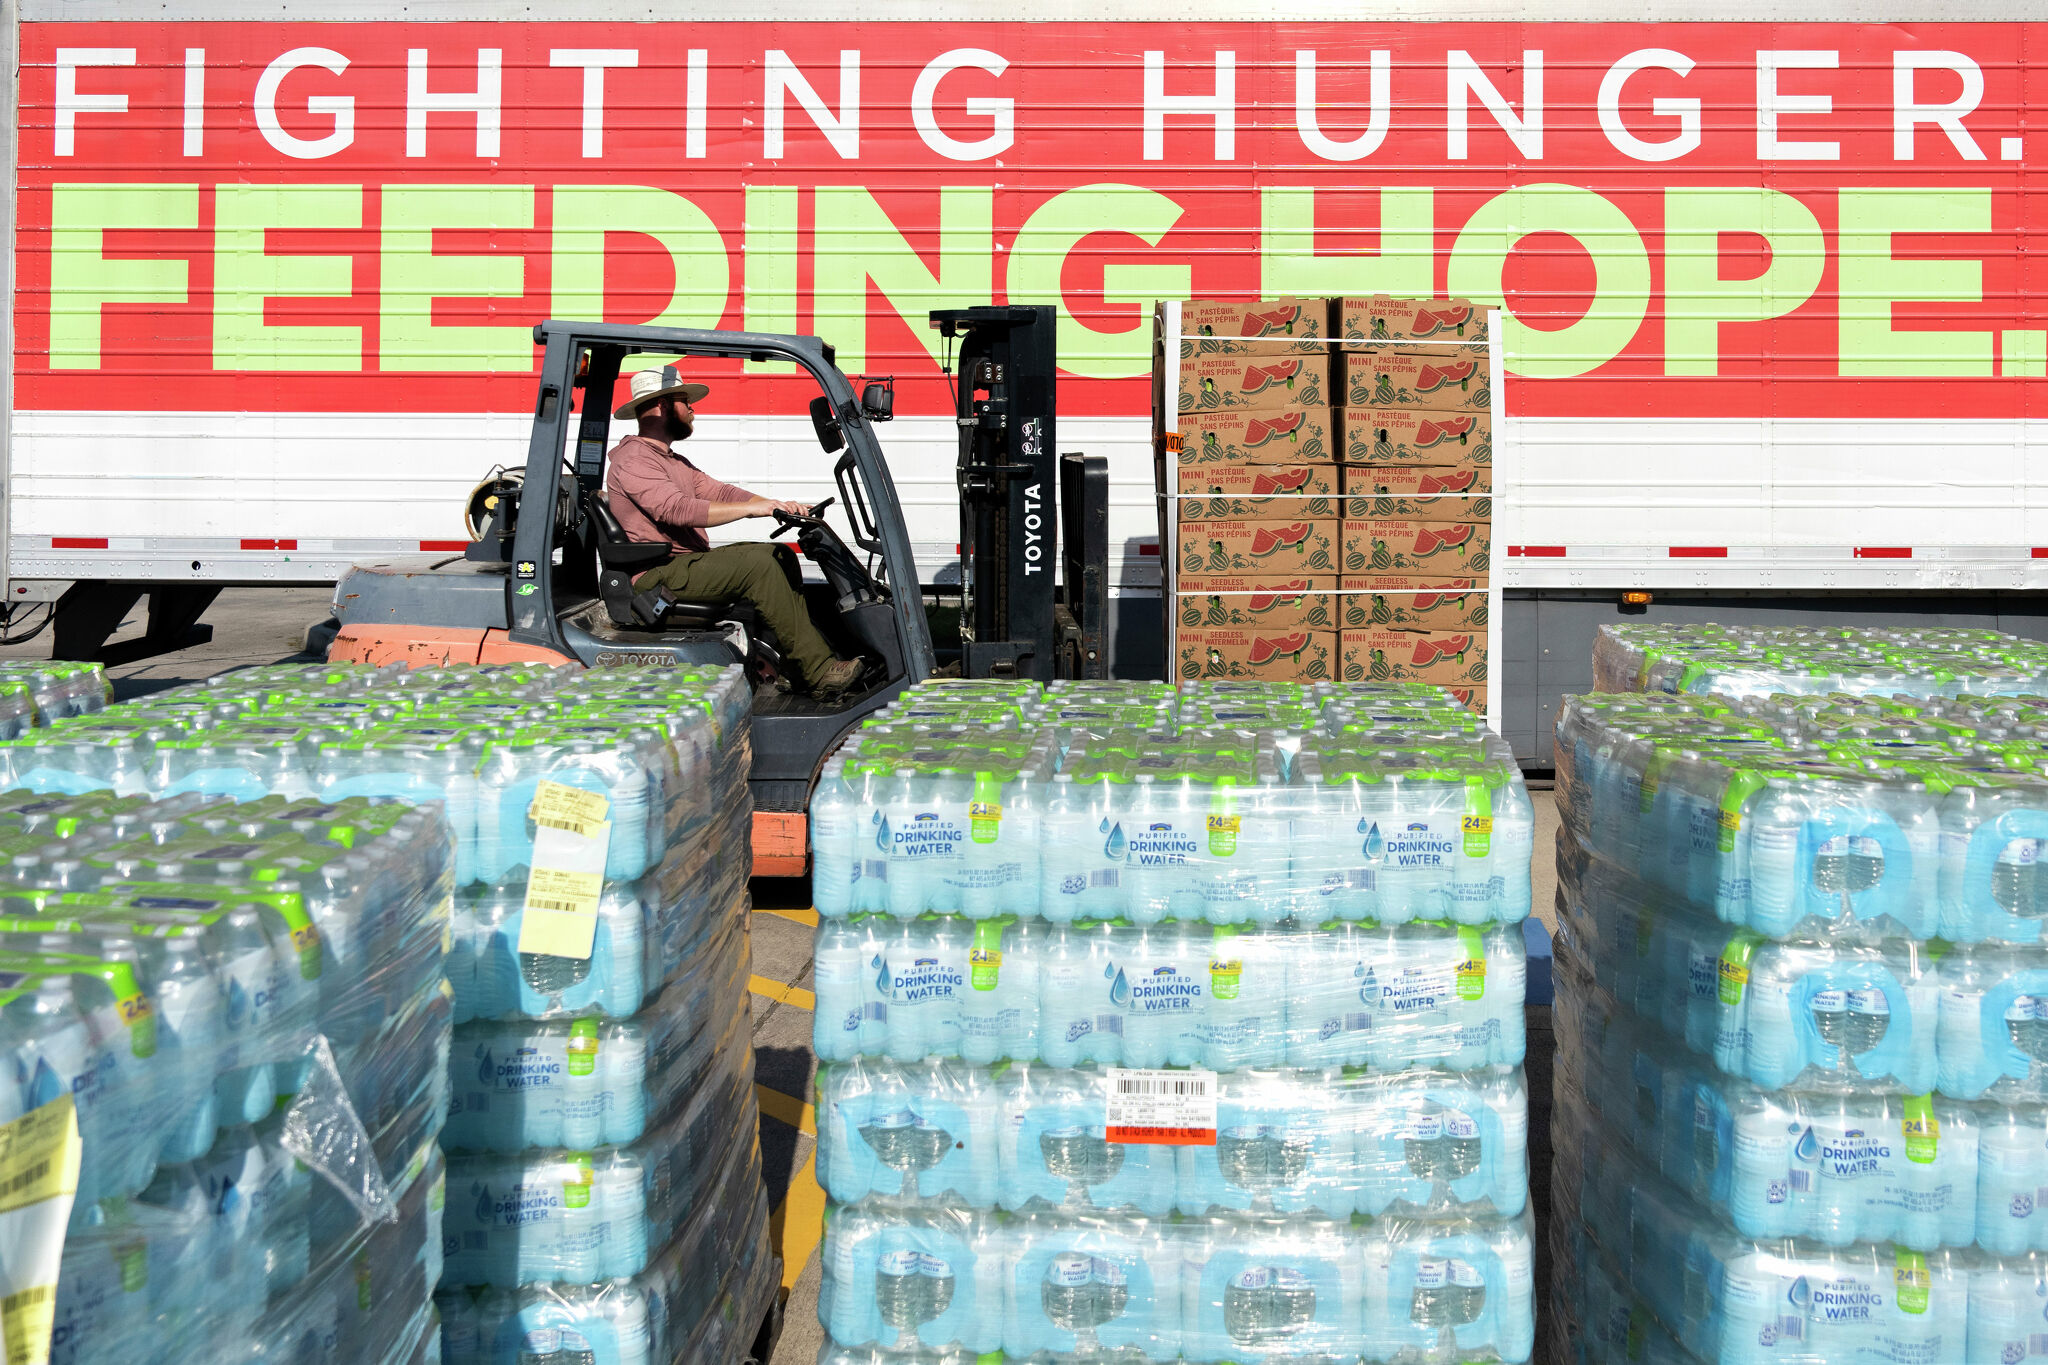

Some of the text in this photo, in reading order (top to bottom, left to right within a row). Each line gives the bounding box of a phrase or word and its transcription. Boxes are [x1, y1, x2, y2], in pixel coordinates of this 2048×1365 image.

[53, 46, 2023, 162] FIGHTING HUNGER.
[49, 182, 2048, 380] FEEDING HOPE.
[1345, 300, 1368, 309] MINI
[1374, 300, 1408, 309] PASTÈQUE
[1181, 311, 1194, 320] INI
[1200, 307, 1235, 316] PASTÈQUE
[1369, 308, 1413, 318] SANS PÉPINS
[1196, 315, 1240, 325] SANS PÉPINS
[1201, 359, 1236, 369] PASTÈQUE
[1349, 357, 1372, 366] MINI
[1378, 356, 1413, 365] PASTÈQUE
[1180, 363, 1195, 371] INI
[1197, 367, 1242, 377] SANS PÉPINS
[1373, 364, 1417, 374] SANS PÉPINS
[1204, 413, 1239, 422] PASTÈQUE
[1348, 412, 1371, 421] MINI
[1376, 411, 1411, 420] PASTÈQUE
[1199, 421, 1244, 432] SANS PÉPINS
[1372, 420, 1416, 429] SANS PÉPINS
[1181, 471, 1205, 480] MINI
[1210, 467, 1246, 476] PASTÈQUE
[1348, 468, 1371, 477] MINI
[1377, 467, 1412, 475] PASTÈQUE
[1206, 475, 1252, 485] SANS PÉPINS
[1372, 475, 1417, 484] SANS PÉPINS
[1024, 483, 1042, 576] TOYOTA
[1182, 524, 1205, 533] MINI
[1211, 521, 1246, 530] PASTÈQUE
[1345, 522, 1368, 531] MINI
[1374, 521, 1409, 529] PASTÈQUE
[1207, 529, 1252, 539] SANS PÉPINS
[1369, 529, 1414, 538] SANS PÉPINS
[1180, 581, 1204, 590] MINI
[1210, 578, 1244, 586] SEEDLESS
[1344, 580, 1368, 589] MINI
[1374, 577, 1408, 585] SEEDLESS
[1180, 633, 1203, 643] MINI
[1209, 631, 1244, 640] SEEDLESS
[1343, 633, 1366, 642] MINI
[1372, 632, 1407, 641] PASTÈQUE
[1204, 638, 1249, 647] WATERMELON
[1367, 640, 1412, 649] SANS PÉPINS
[619, 654, 676, 666] TOYOTA
[971, 803, 987, 815] 24
[1208, 816, 1223, 828] 24
[1464, 816, 1480, 829] 24
[895, 830, 962, 843] DRINKING
[906, 842, 953, 856] WATER
[1130, 840, 1197, 852] DRINKING
[1387, 841, 1453, 853] DRINKING
[1140, 854, 1186, 865] WATER
[1398, 854, 1441, 865] WATER
[294, 926, 317, 946] 24
[971, 950, 987, 962] 24
[1211, 959, 1227, 971] 24
[1719, 959, 1731, 974] 24
[895, 975, 963, 988] DRINKING
[906, 986, 953, 1000] WATER
[1133, 985, 1201, 998] DRINKING
[1144, 998, 1190, 1011] WATER
[1393, 998, 1435, 1010] WATER
[497, 1063, 560, 1076] DRINKING
[506, 1075, 550, 1088] WATER
[1904, 1120, 1922, 1133] 24
[1822, 1146, 1890, 1160] DRINKING
[1834, 1160, 1878, 1175] WATER
[495, 1197, 558, 1213] DRINKING
[505, 1209, 549, 1225] WATER
[1896, 1269, 1913, 1281] 24
[1813, 1292, 1882, 1306] DRINKING
[1825, 1306, 1869, 1320] WATER
